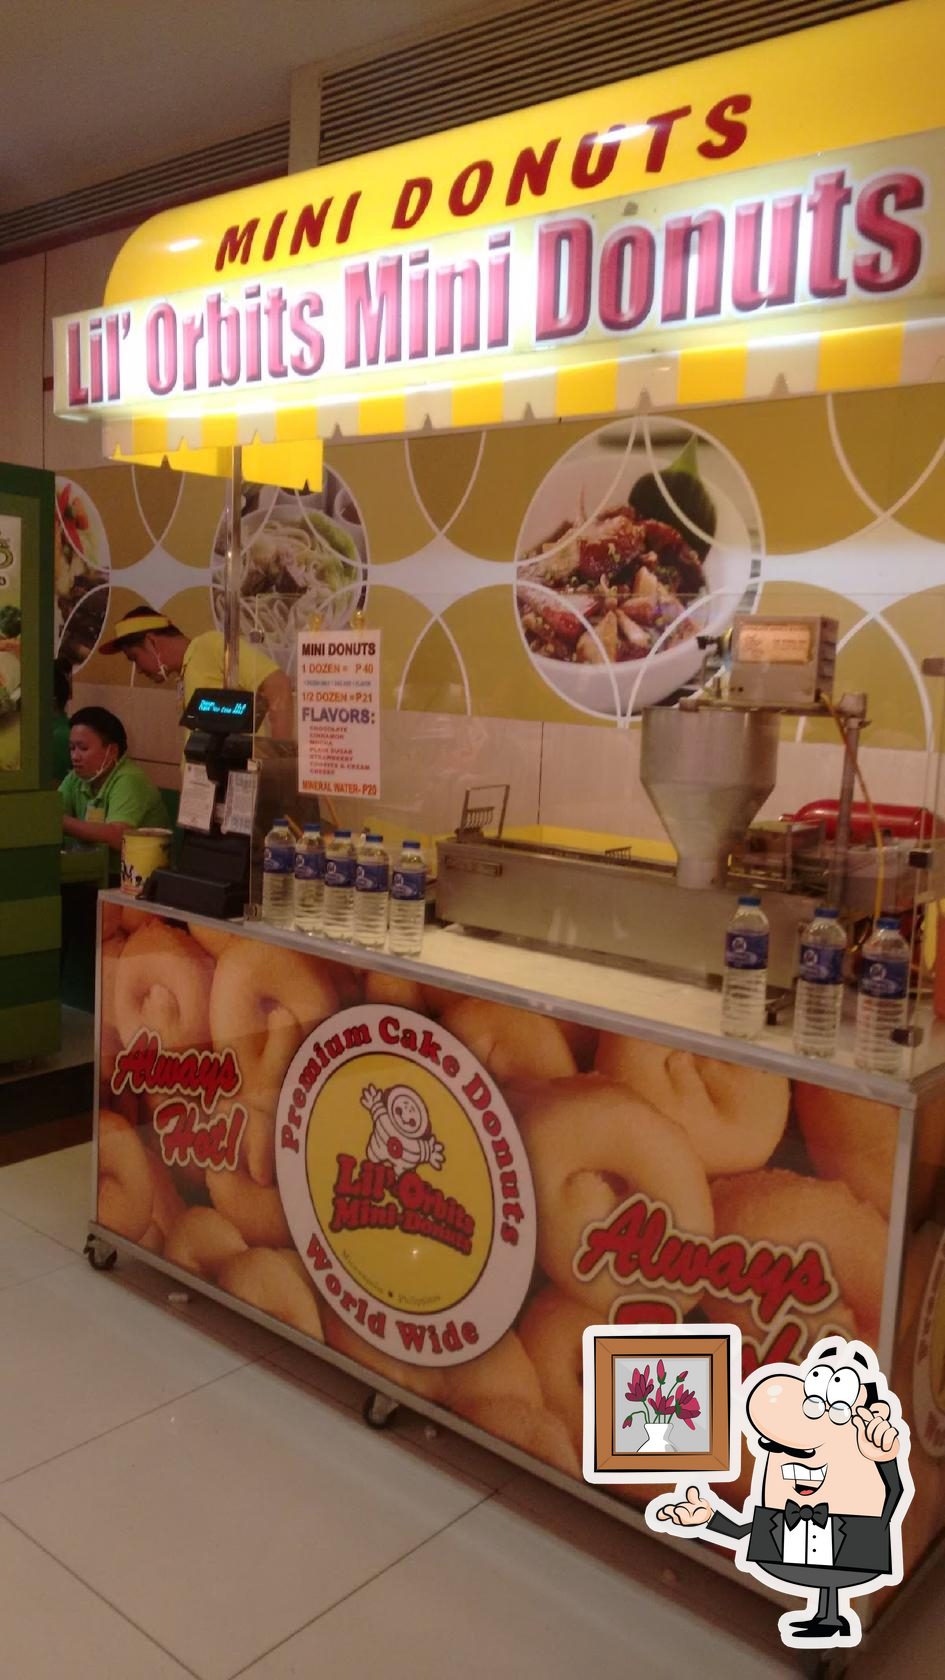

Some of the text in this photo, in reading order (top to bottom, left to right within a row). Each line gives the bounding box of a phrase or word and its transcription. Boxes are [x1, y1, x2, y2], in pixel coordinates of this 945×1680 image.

[215, 94, 752, 271] MINI DONUTS
[146, 283, 325, 396] Orbits
[344, 231, 511, 369] Mini
[535, 169, 925, 342] Donuts
[302, 642, 376, 656] MINI DONUTS
[309, 664, 340, 673] DOZEN
[302, 707, 375, 724] FLAVORS:
[316, 692, 347, 703] DOZEN
[303, 780, 332, 792] MINERAL
[112, 1029, 240, 1111] Always
[281, 1016, 526, 1247] Premium Cake Donuts
[306, 1232, 479, 1354] World Wide
[575, 1197, 835, 1320] Always
